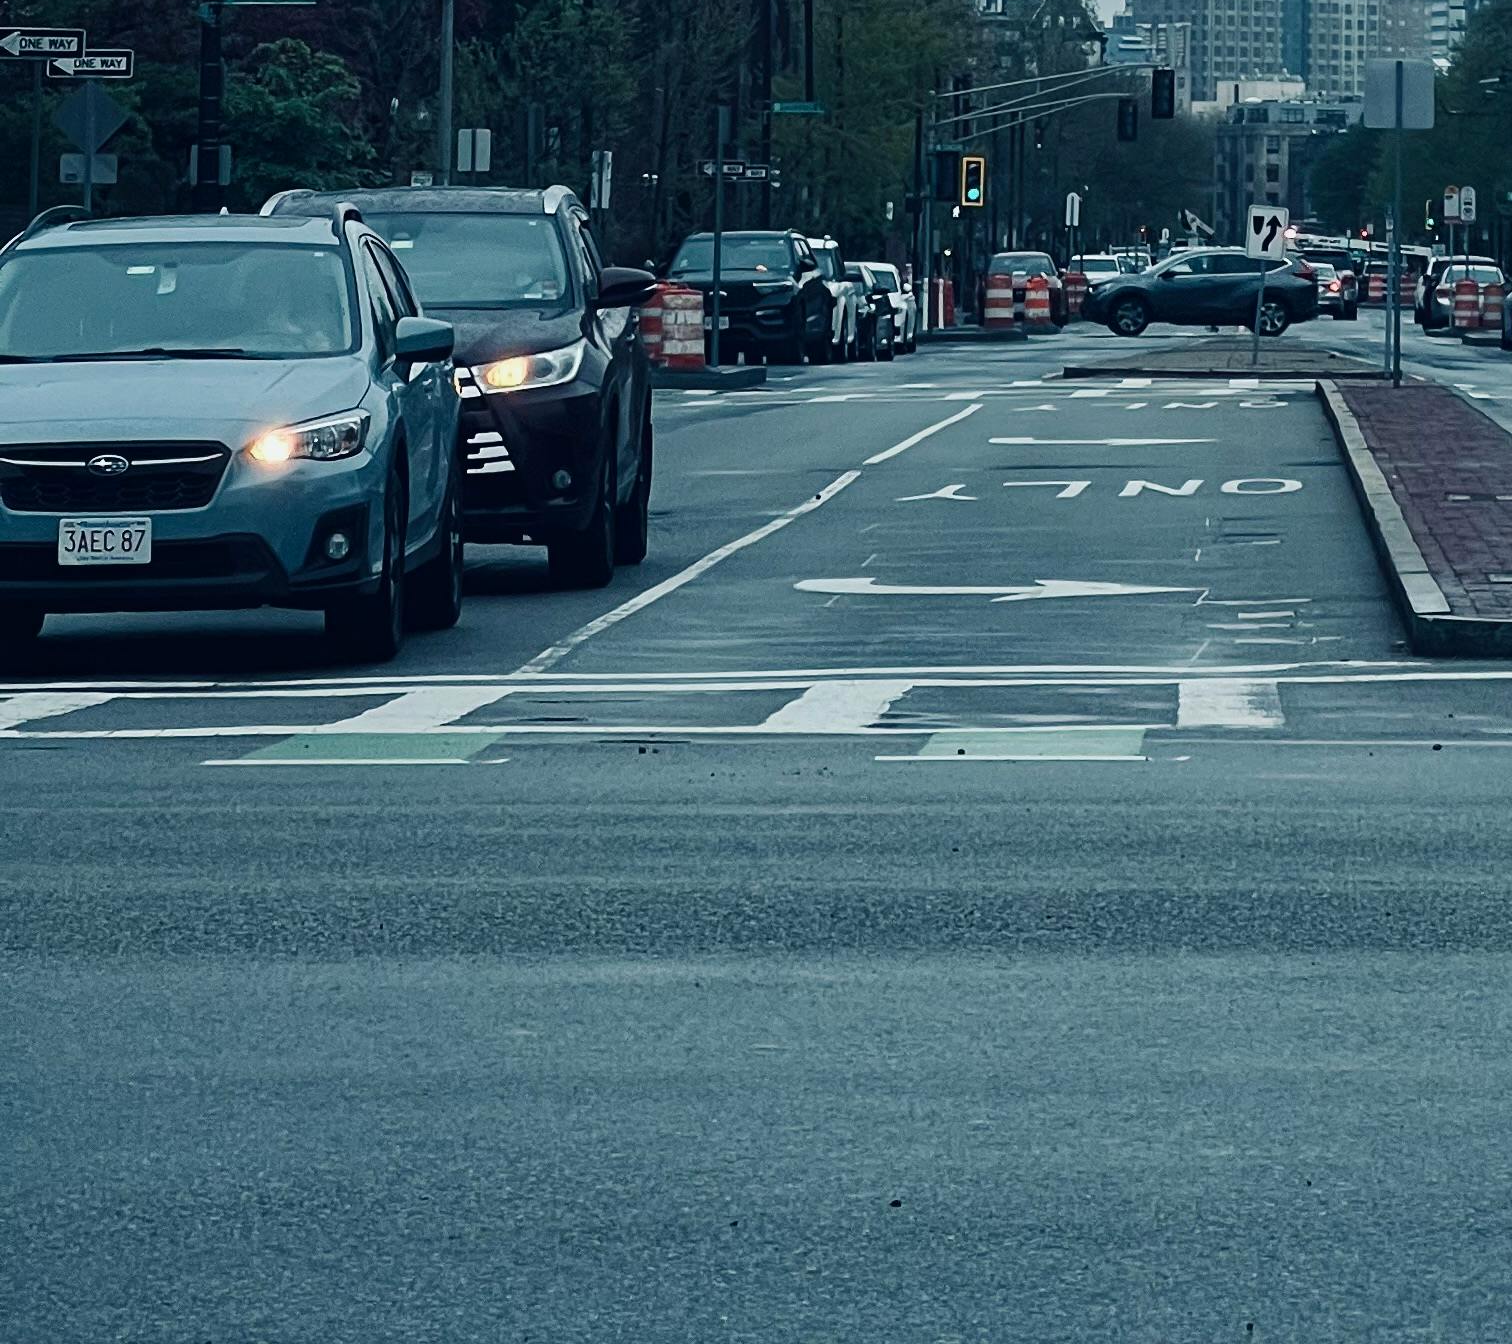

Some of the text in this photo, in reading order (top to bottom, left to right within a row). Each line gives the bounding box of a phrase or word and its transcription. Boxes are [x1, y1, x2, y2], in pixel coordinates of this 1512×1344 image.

[19, 38, 74, 50] ONE WAY
[74, 58, 123, 68] ONE WAY
[894, 478, 1303, 501] ONLY
[64, 529, 146, 553] 3AEC 87
